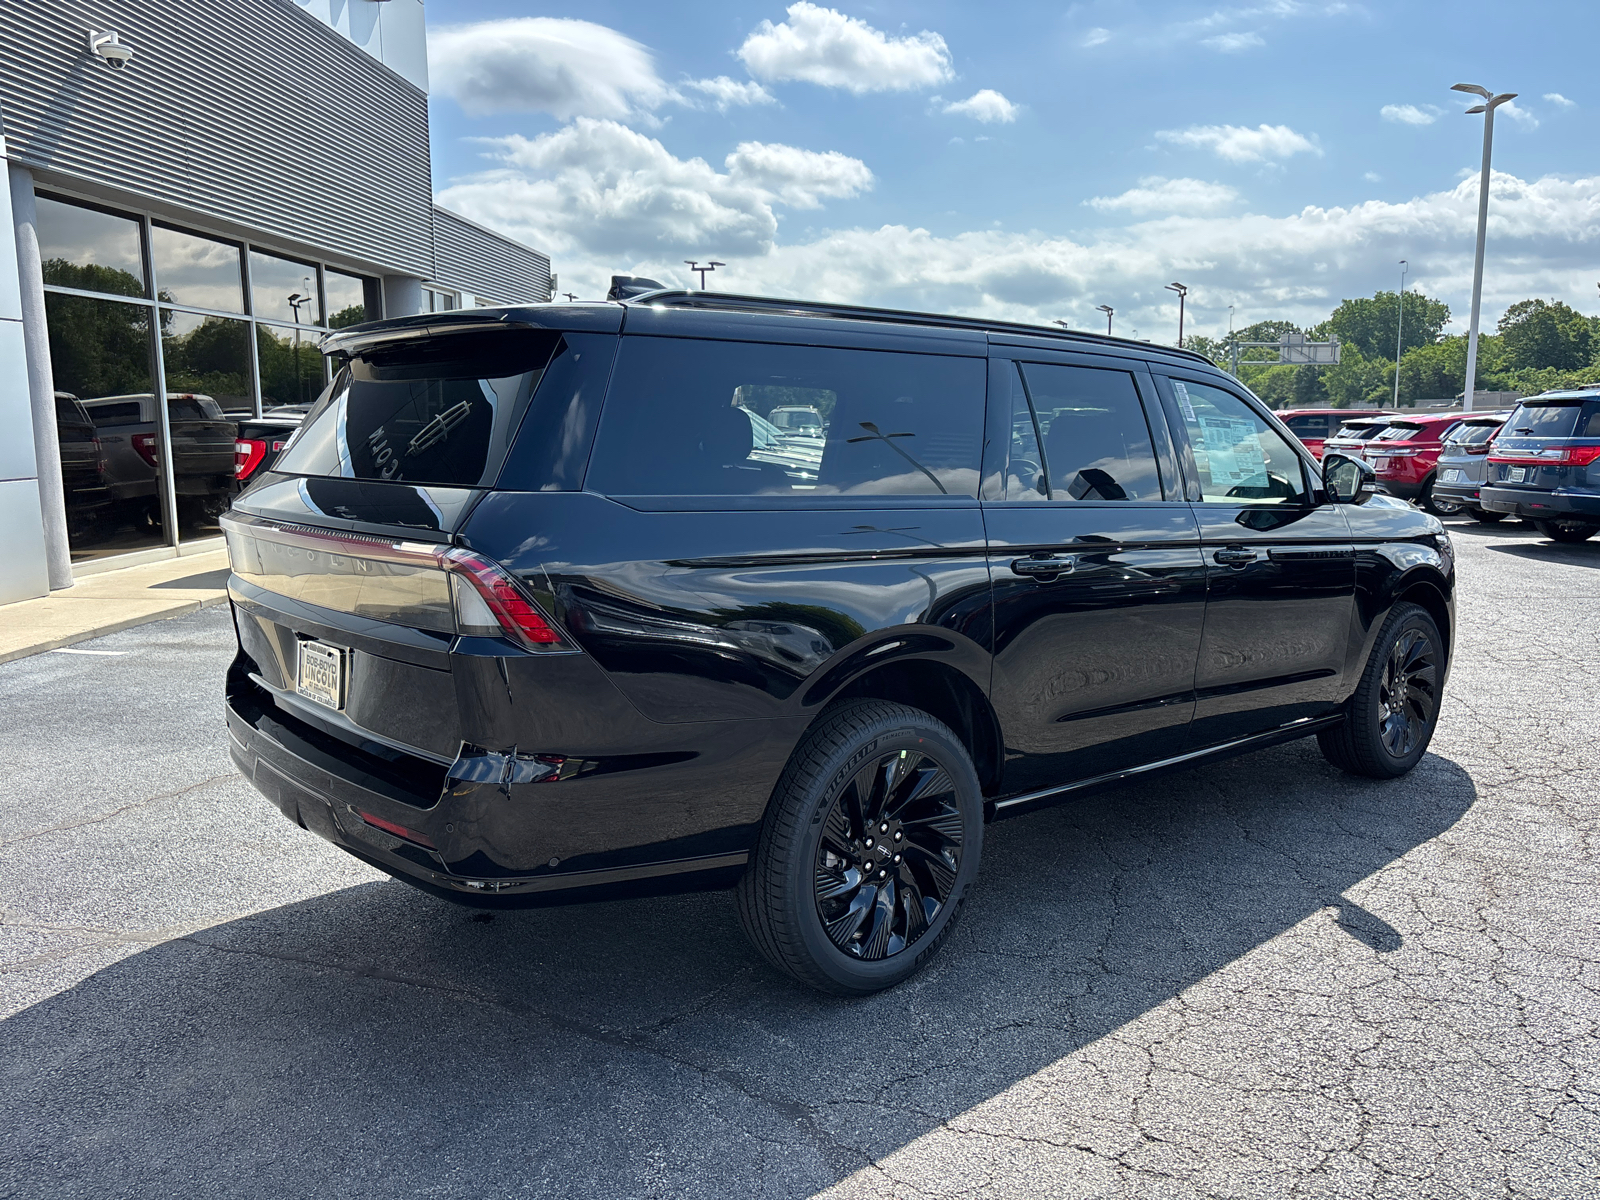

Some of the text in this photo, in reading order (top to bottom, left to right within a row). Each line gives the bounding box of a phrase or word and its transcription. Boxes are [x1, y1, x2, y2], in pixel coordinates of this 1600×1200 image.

[267, 542, 368, 572] NCOLN
[304, 664, 337, 690] LINCOLN
[824, 741, 876, 802] MICHELIN
[917, 904, 961, 963] MICHELIN
